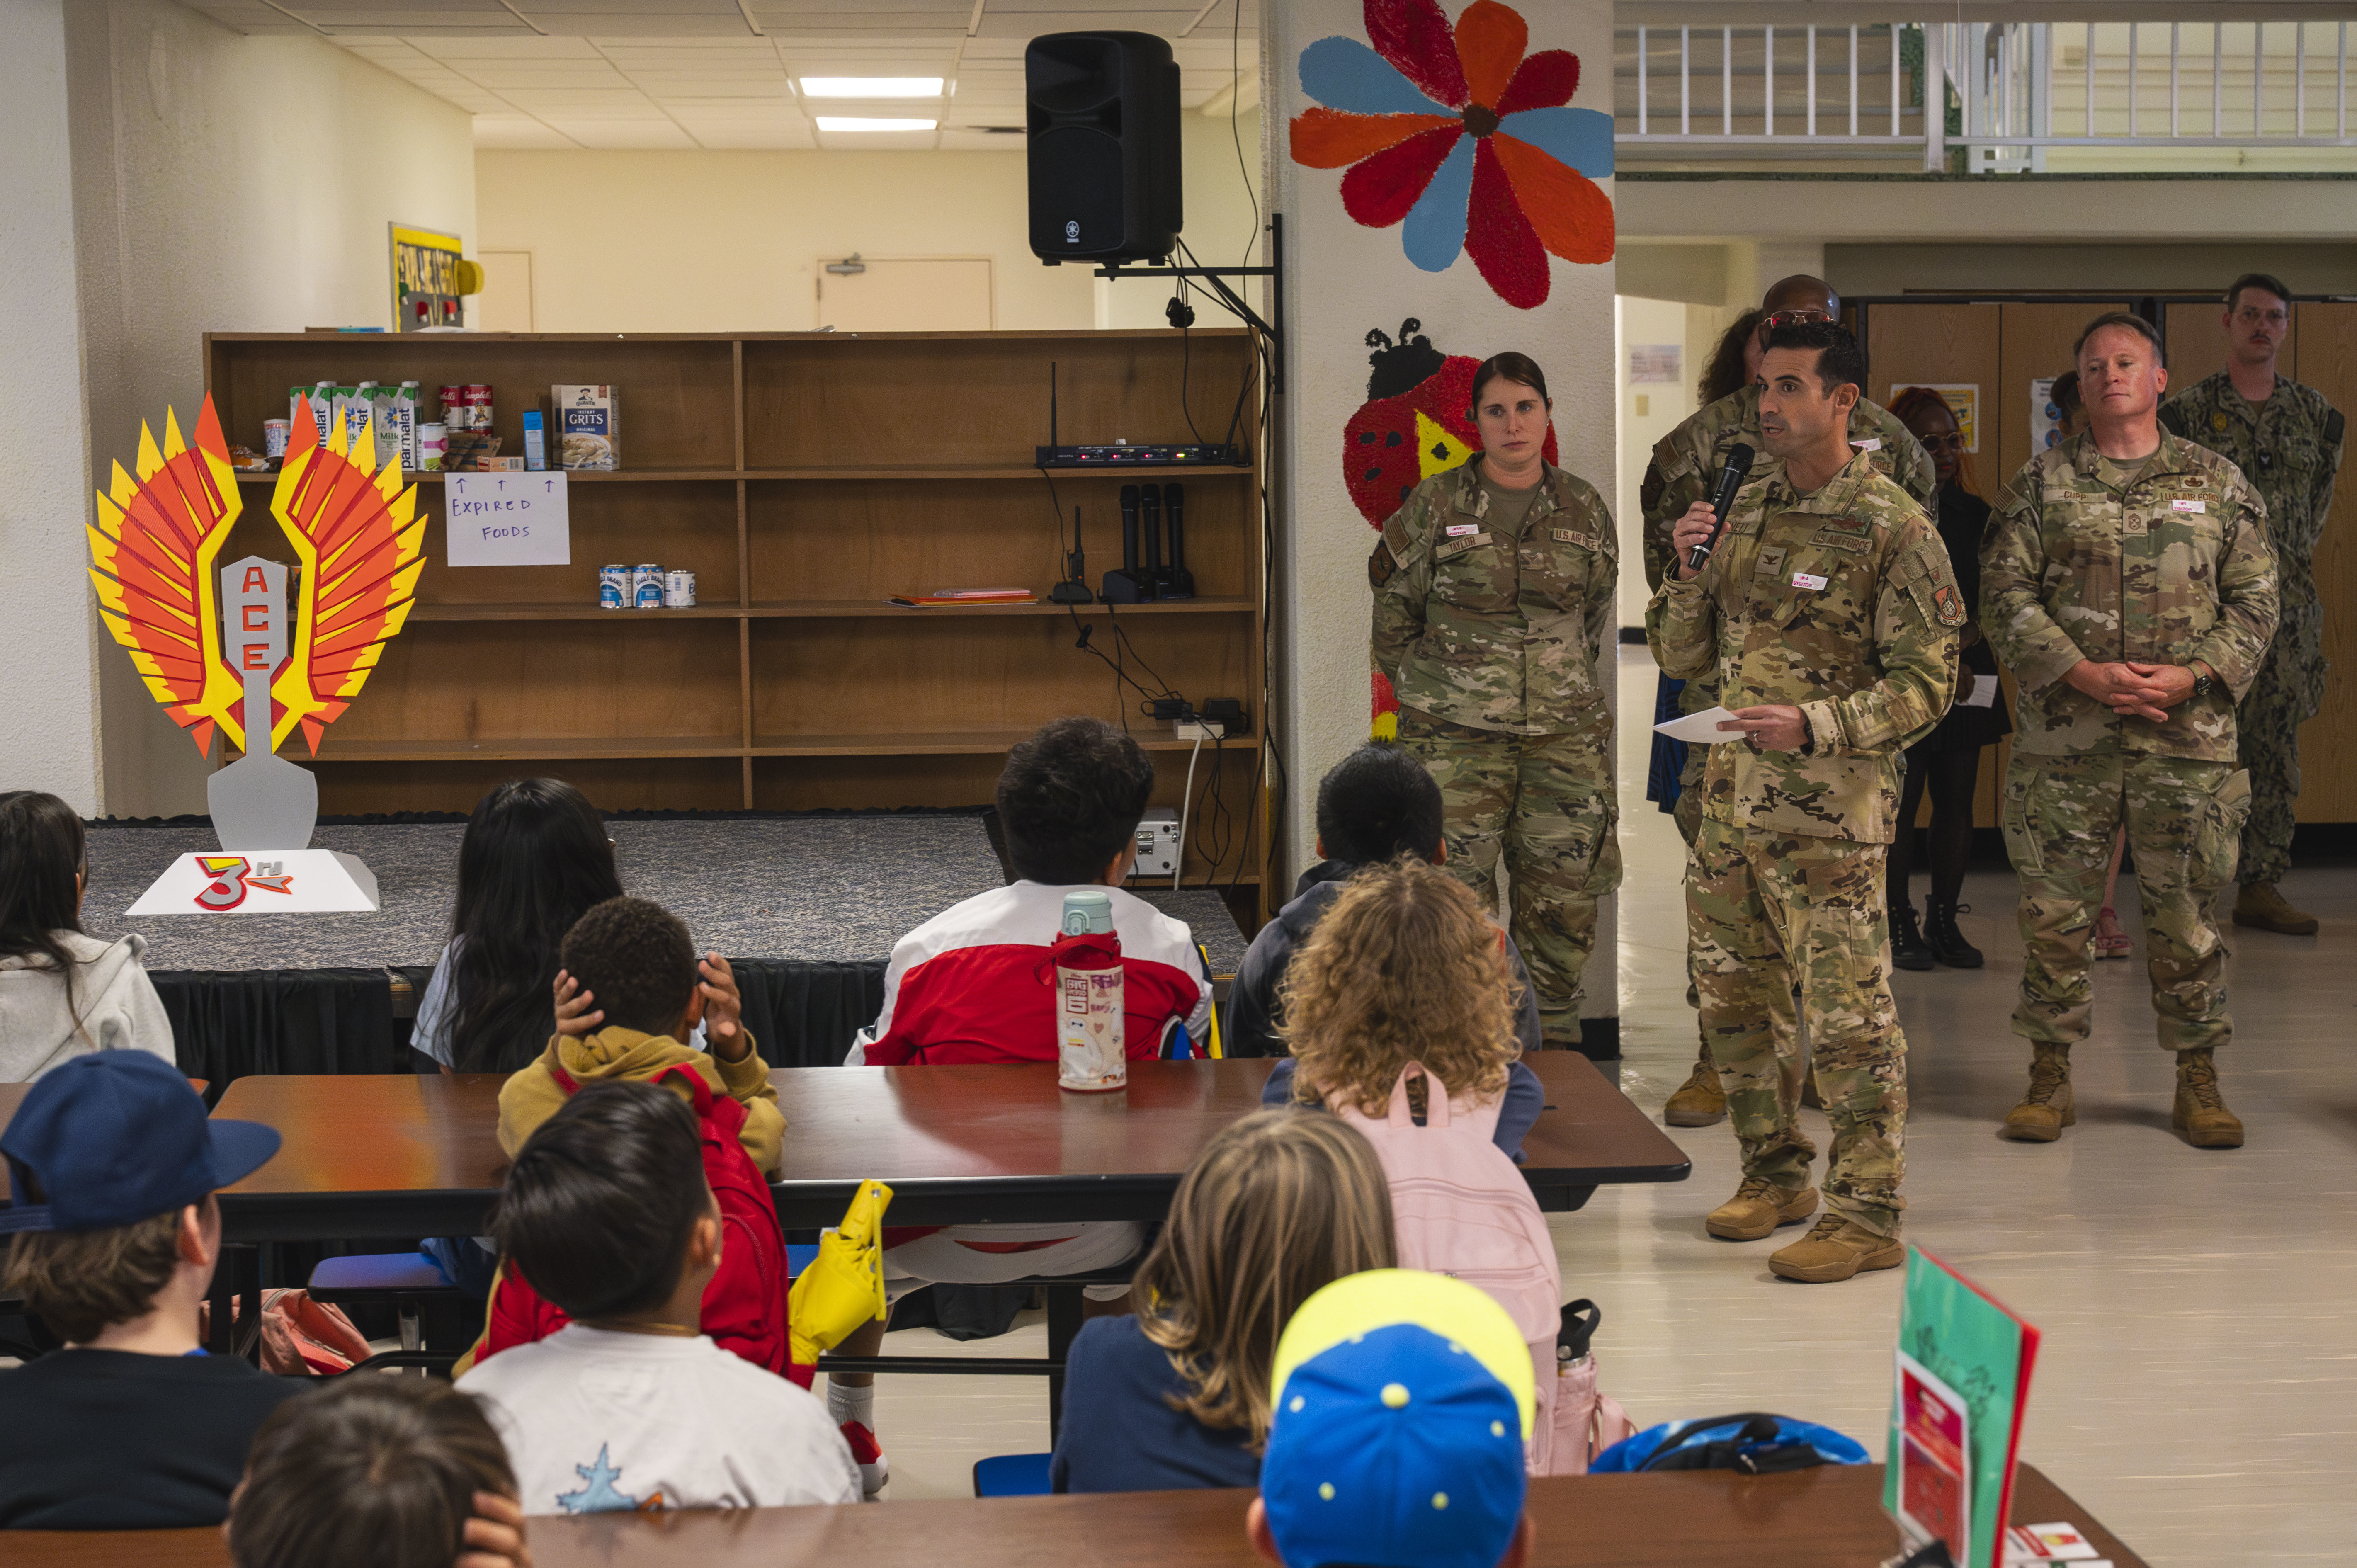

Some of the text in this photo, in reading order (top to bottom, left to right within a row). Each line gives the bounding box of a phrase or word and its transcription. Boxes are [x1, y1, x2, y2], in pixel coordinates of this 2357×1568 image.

[569, 414, 604, 425] GRITS
[315, 409, 327, 447] malat
[399, 407, 413, 468] parmalat
[2064, 491, 2086, 500] CUPP
[2182, 493, 2196, 501] AIR
[452, 499, 531, 516] EXPIRED
[482, 526, 529, 540] FOODS
[1571, 532, 1582, 544] AIR
[1449, 536, 1476, 553] TAYLOR
[1827, 534, 1841, 546] AIR
[1842, 536, 1871, 552] FORCE
[1067, 979, 1087, 990] BIG
